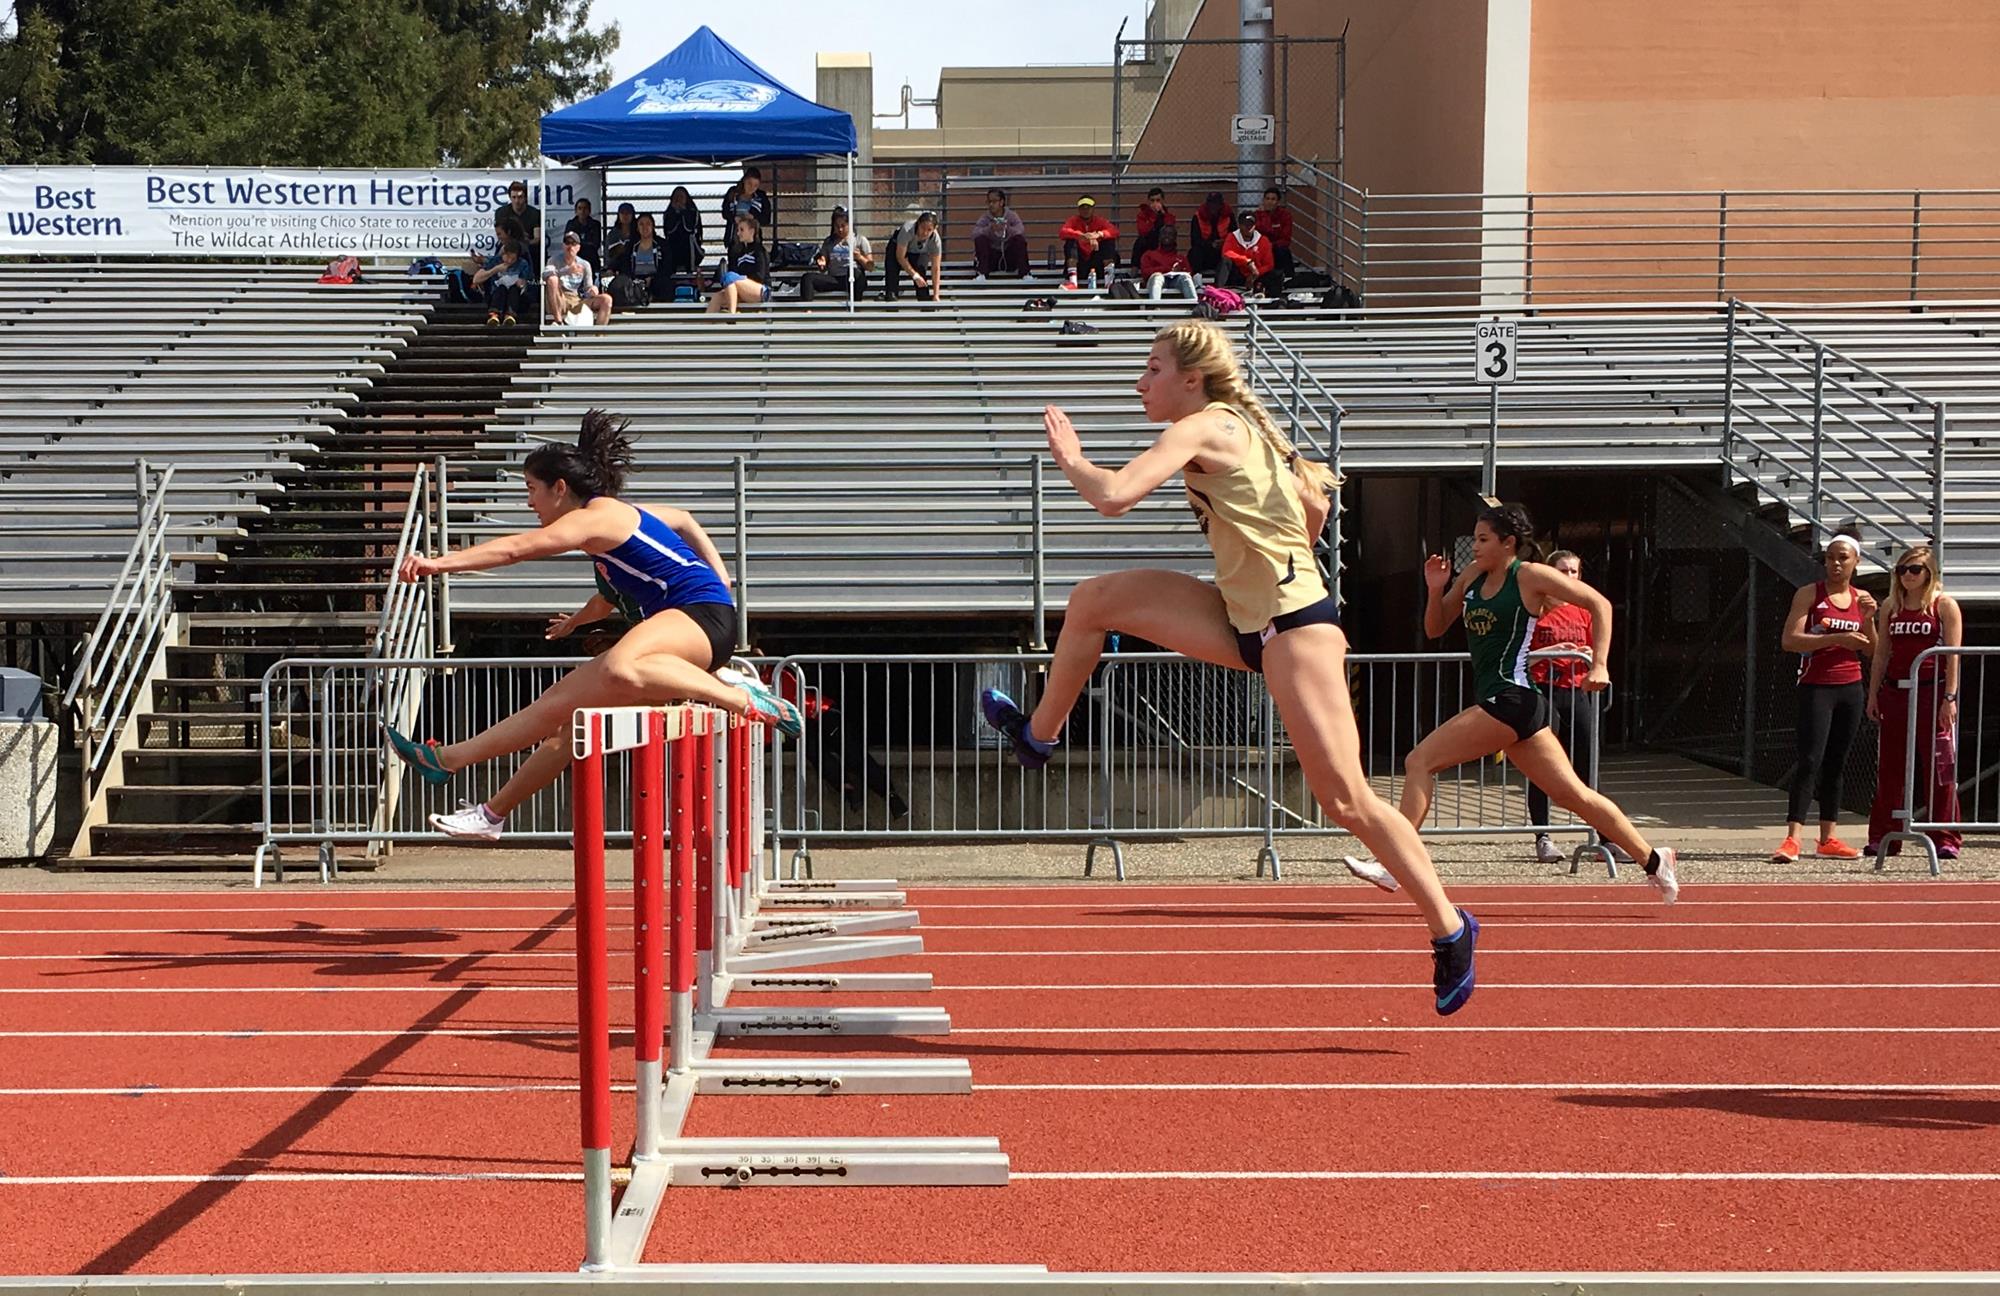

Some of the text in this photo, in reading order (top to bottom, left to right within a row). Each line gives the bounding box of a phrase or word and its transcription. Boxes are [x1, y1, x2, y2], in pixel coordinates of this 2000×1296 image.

[35, 185, 97, 210] Best
[147, 176, 216, 204] Best
[225, 177, 357, 205] Western
[370, 177, 509, 213] Heritage
[7, 211, 122, 236] Western
[169, 214, 222, 227] Mention
[226, 215, 267, 230] you're
[271, 215, 317, 230] visiting
[320, 216, 356, 229] Chico
[360, 216, 392, 229] State
[396, 216, 409, 229] to
[413, 216, 458, 229] receive
[460, 219, 468, 229] a
[172, 231, 205, 248] The
[211, 231, 275, 248] Wildcat
[280, 232, 357, 249] Athletics
[362, 232, 410, 251] (Host
[416, 233, 471, 251] Hotel)
[1479, 326, 1514, 338] GATE
[1484, 340, 1508, 378] 3
[1889, 621, 1931, 635] CHICO
